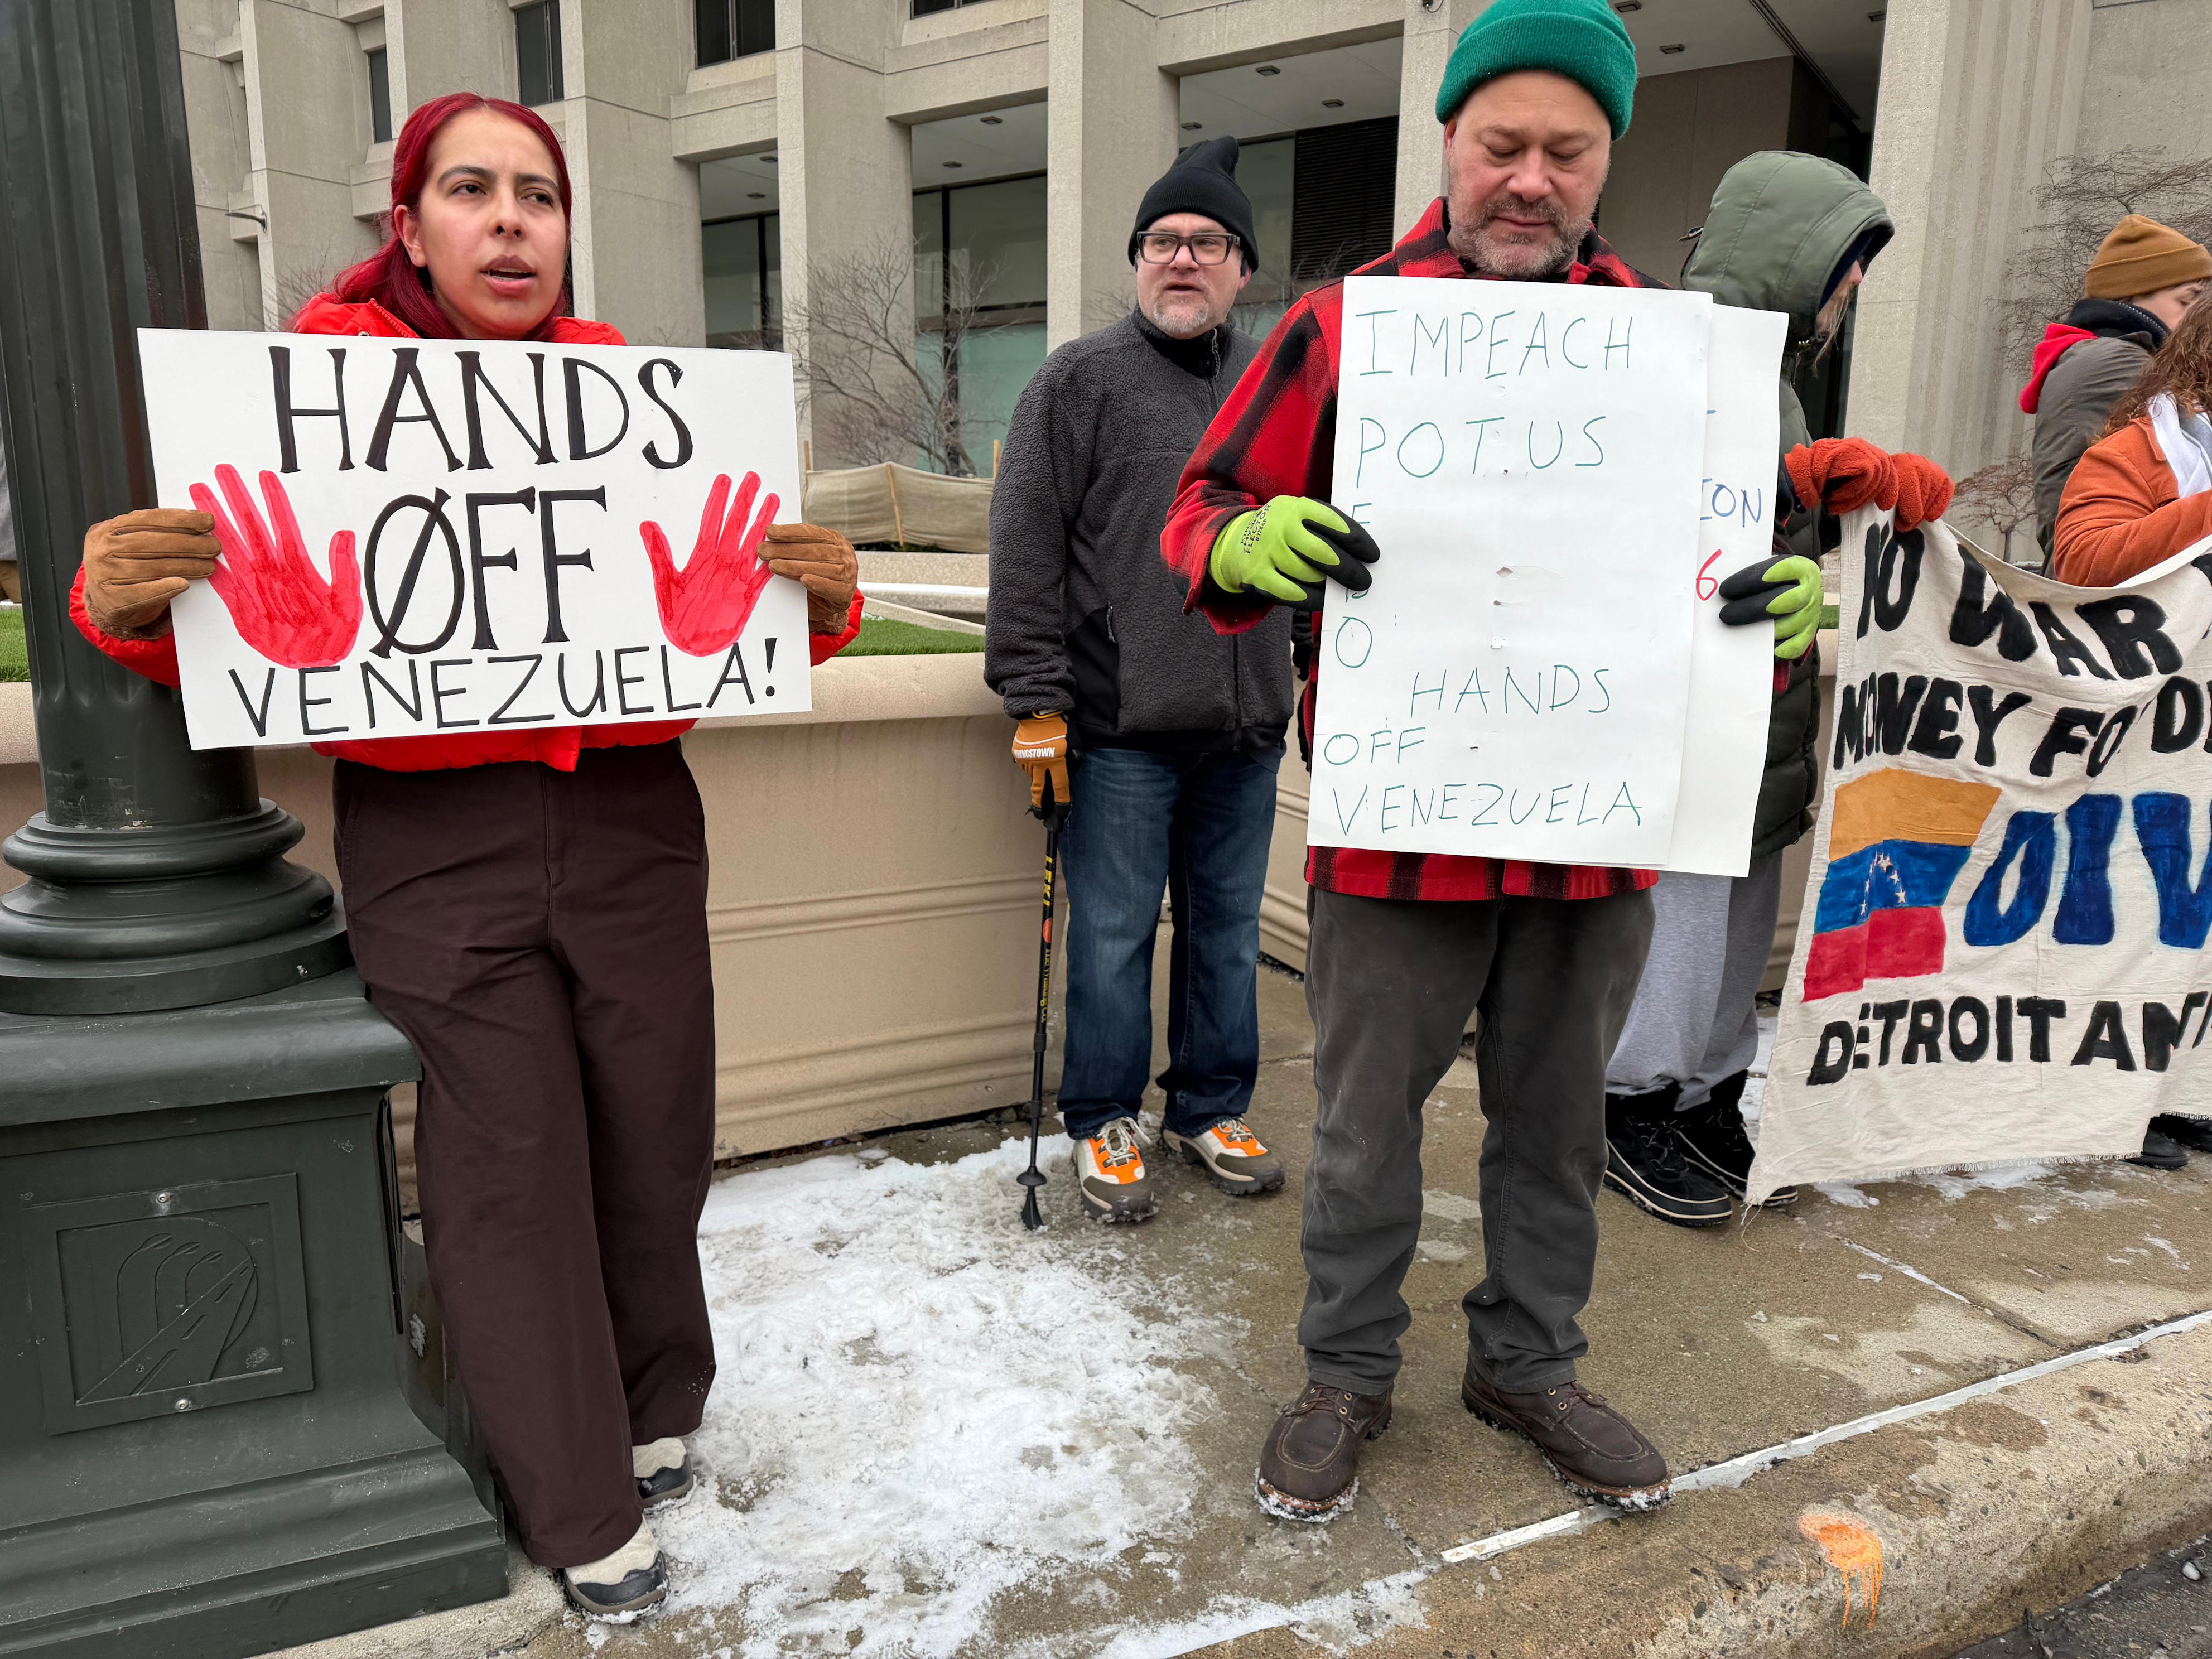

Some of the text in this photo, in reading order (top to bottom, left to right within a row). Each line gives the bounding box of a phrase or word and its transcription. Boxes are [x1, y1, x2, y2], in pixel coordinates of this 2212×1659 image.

[1355, 310, 1633, 379] IMPEACH
[268, 346, 693, 473] HANDS
[1356, 416, 1606, 489] POTUS
[1949, 543, 2184, 680] WAR
[228, 637, 777, 737] VENEZUELA!
[1410, 665, 1610, 718] HANDS
[1833, 672, 2032, 770] MONEY
[1324, 727, 1425, 765] OFF
[1333, 781, 1642, 836] VENEZUELA
[1806, 995, 2068, 1086] DETROIT
